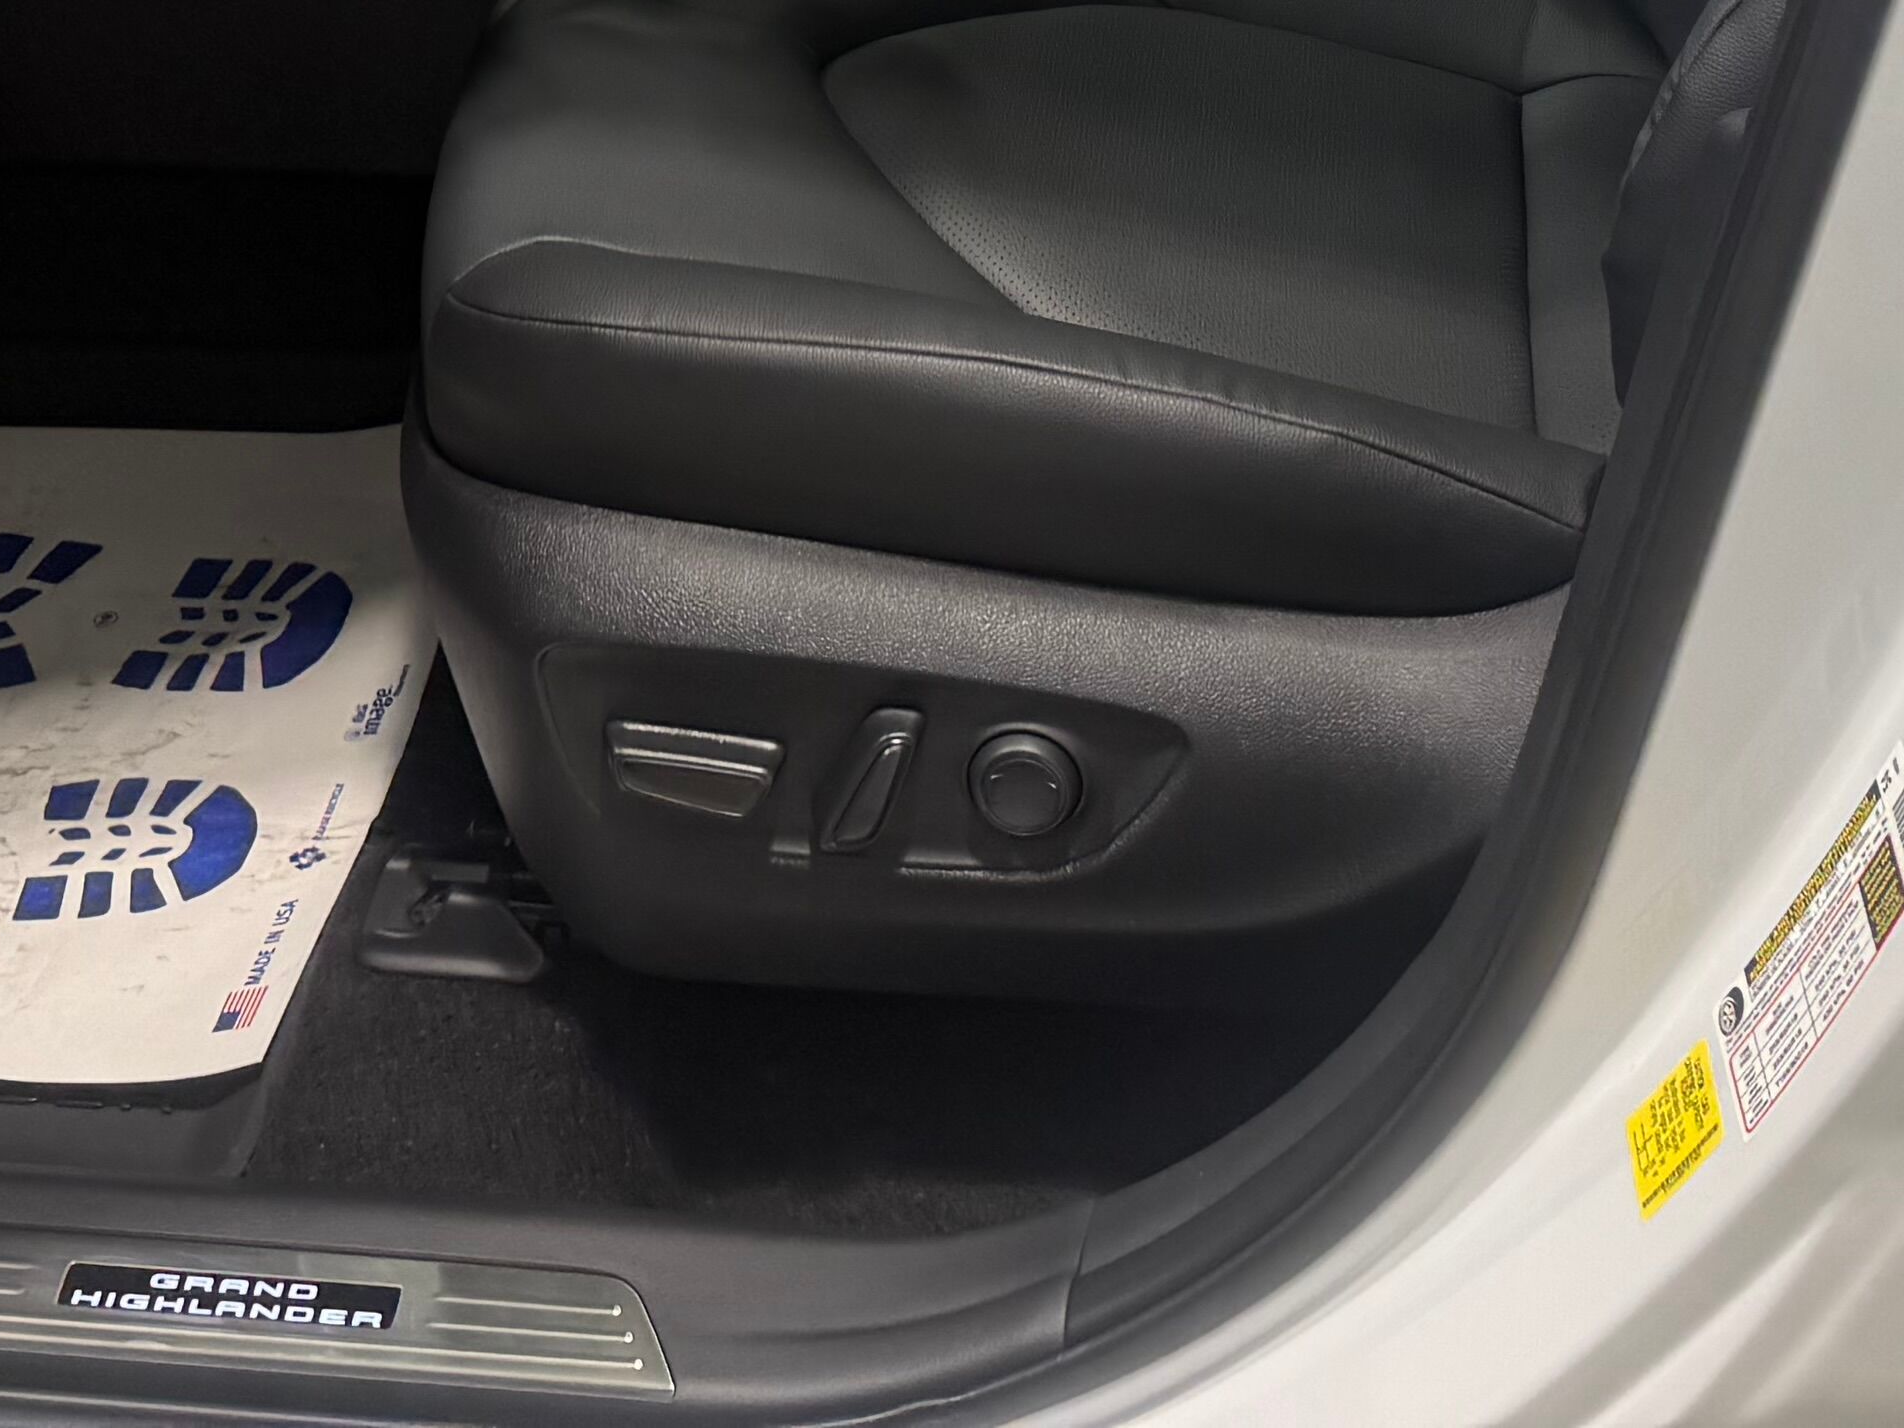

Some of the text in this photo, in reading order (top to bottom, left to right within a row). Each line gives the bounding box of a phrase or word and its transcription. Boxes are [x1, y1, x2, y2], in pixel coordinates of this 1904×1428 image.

[244, 899, 299, 986] MADE IN USA
[149, 1272, 319, 1301] GRAND
[70, 1288, 383, 1329] HIGHLANDER
